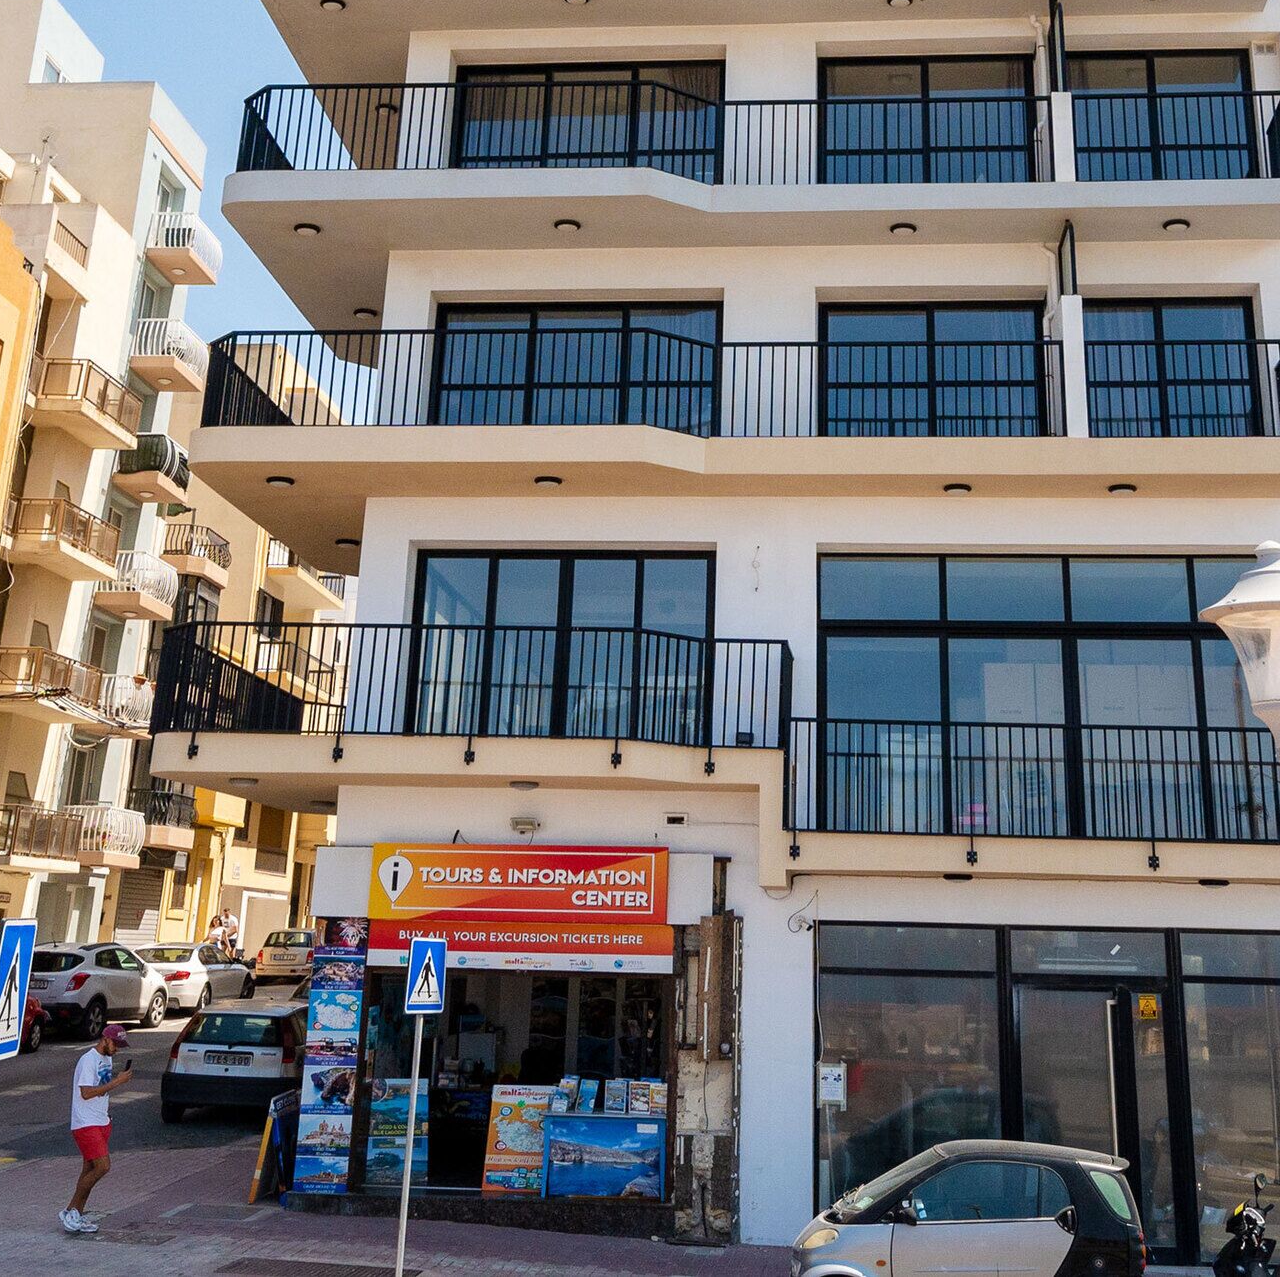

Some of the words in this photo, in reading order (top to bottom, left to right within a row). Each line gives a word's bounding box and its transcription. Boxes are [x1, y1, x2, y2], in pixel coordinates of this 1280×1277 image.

[419, 867, 484, 884] TOURS
[488, 868, 503, 884] &
[508, 868, 646, 886] INFORMATION
[571, 890, 649, 907] CENTER
[399, 930, 423, 939] BUY
[453, 931, 486, 941] YOUR
[489, 932, 558, 943] EXCURSION
[562, 933, 610, 944] TICKETS
[613, 935, 643, 945] HERE
